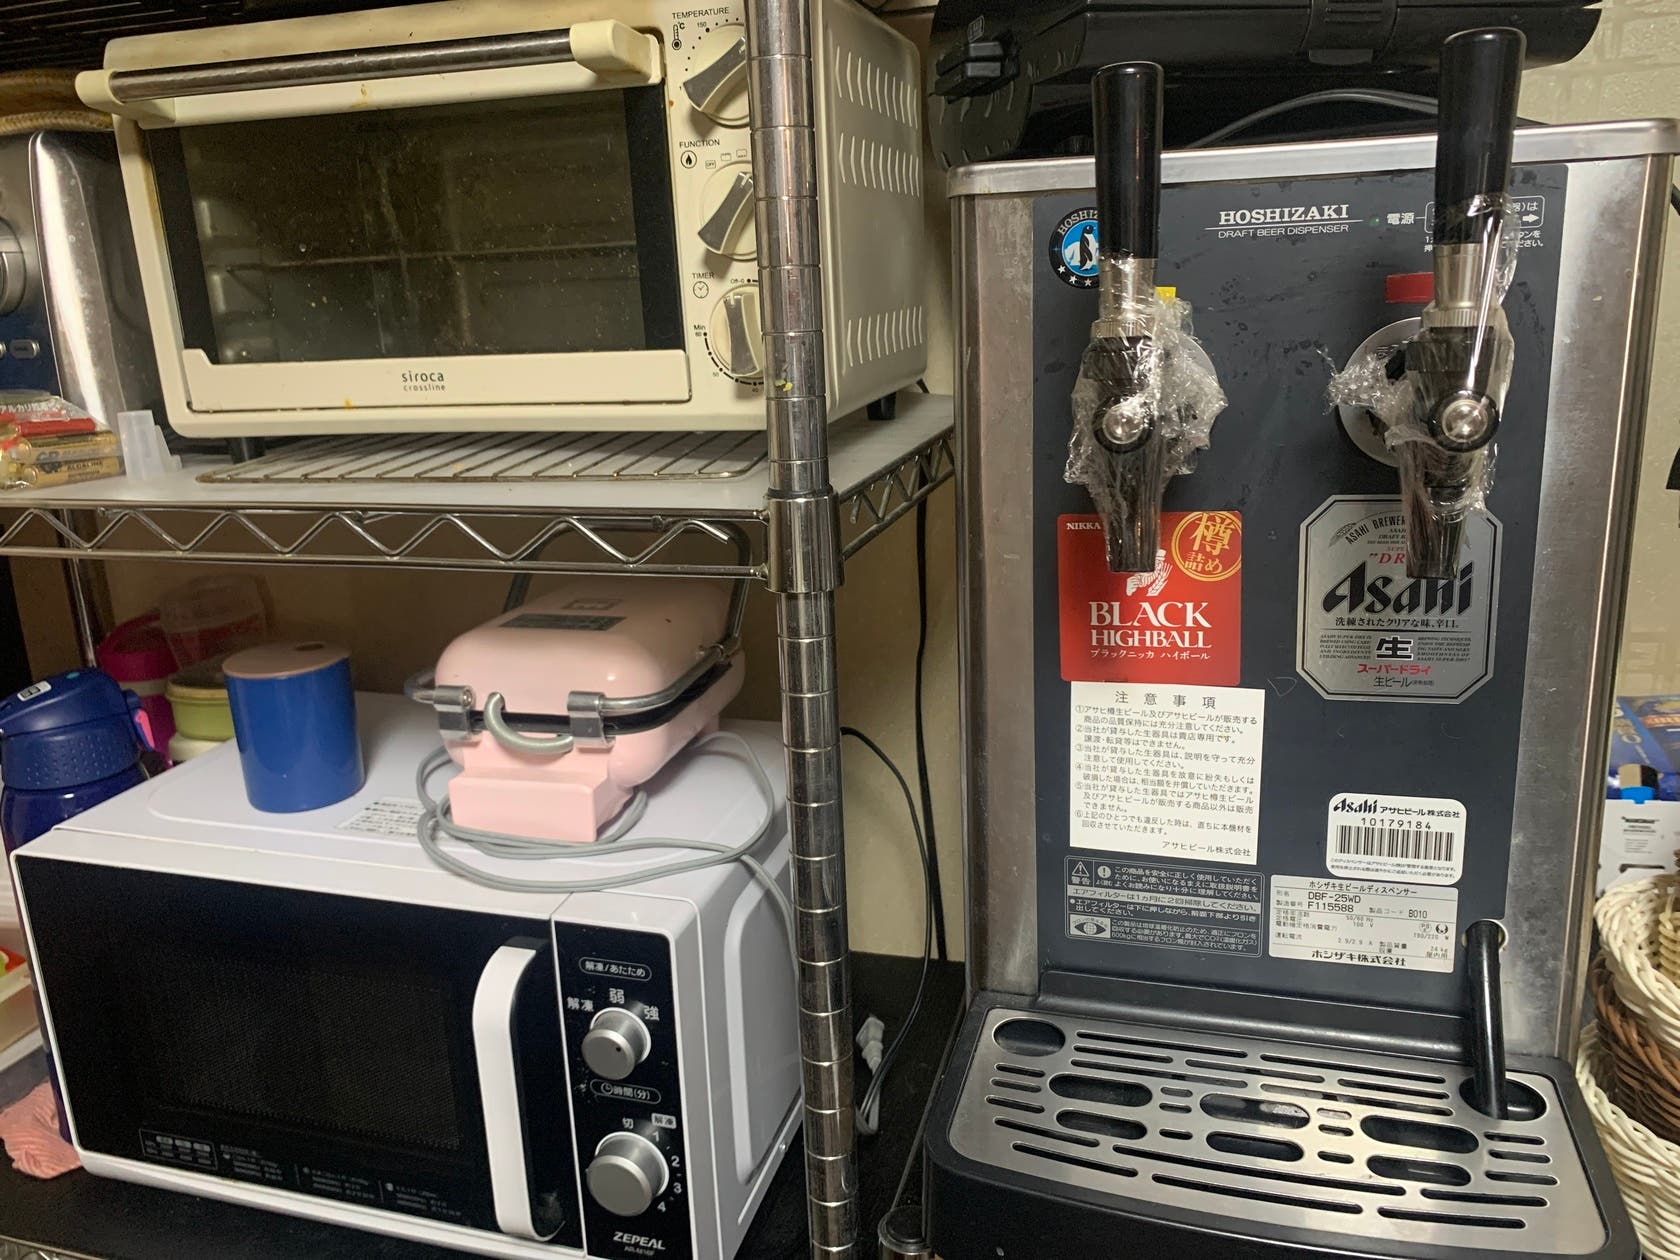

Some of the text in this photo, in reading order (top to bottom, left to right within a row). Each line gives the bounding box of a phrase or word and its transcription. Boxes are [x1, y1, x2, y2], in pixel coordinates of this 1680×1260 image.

[672, 7, 729, 19] TEMPERATURE
[679, 139, 720, 148] FUNCTION
[1219, 204, 1349, 225] HOSHIZAKI
[1387, 212, 1415, 225] 電源
[1057, 210, 1099, 235] HOSHIZ
[1218, 224, 1349, 239] DRAFT BEER DISPENSER
[692, 271, 715, 279] TIMER
[401, 370, 444, 383] siroca
[403, 384, 446, 392] crossline
[1066, 522, 1102, 530] NIKKA
[1345, 515, 1406, 545] ASAHI BREWER
[1189, 513, 1236, 555] 樽
[1184, 551, 1223, 573] 詰め
[1369, 552, 1406, 564] "DR
[1322, 560, 1473, 615] Asahi
[1089, 601, 1212, 628] BLACK
[1335, 617, 1460, 629] 洗練されたクリアな味、辛口。
[1090, 630, 1212, 649] HIGHBALL
[1091, 649, 1211, 660] ブラックニッカ ハイボール
[1377, 636, 1414, 660] 生
[1357, 663, 1431, 675] スーパードライ
[1373, 676, 1413, 688] 生ビール
[1115, 690, 1216, 710] 注意事項
[1333, 797, 1460, 819] Asahi アサヒビール株式会社
[1361, 817, 1431, 830] 10179184
[1162, 841, 1251, 857] アサヒビール株式会社
[1309, 881, 1417, 896] ホシザキ生ビールディスペンサー
[1308, 891, 1361, 904] DBF-25WD
[1308, 901, 1354, 913] F115588
[1312, 949, 1407, 966] ホシザキ株式会社
[585, 961, 646, 977] 解凍/あたため
[609, 988, 624, 1004] 弱
[567, 996, 594, 1012] 解凍
[644, 1005, 660, 1021] 強
[613, 1085, 650, 1100] 時間(分)
[622, 1117, 634, 1129] 切
[653, 1131, 660, 1142] 1
[671, 1155, 680, 1167] 2
[673, 1182, 682, 1194] 3
[657, 1201, 666, 1212] 4
[613, 1231, 666, 1250] ZEPEAL
